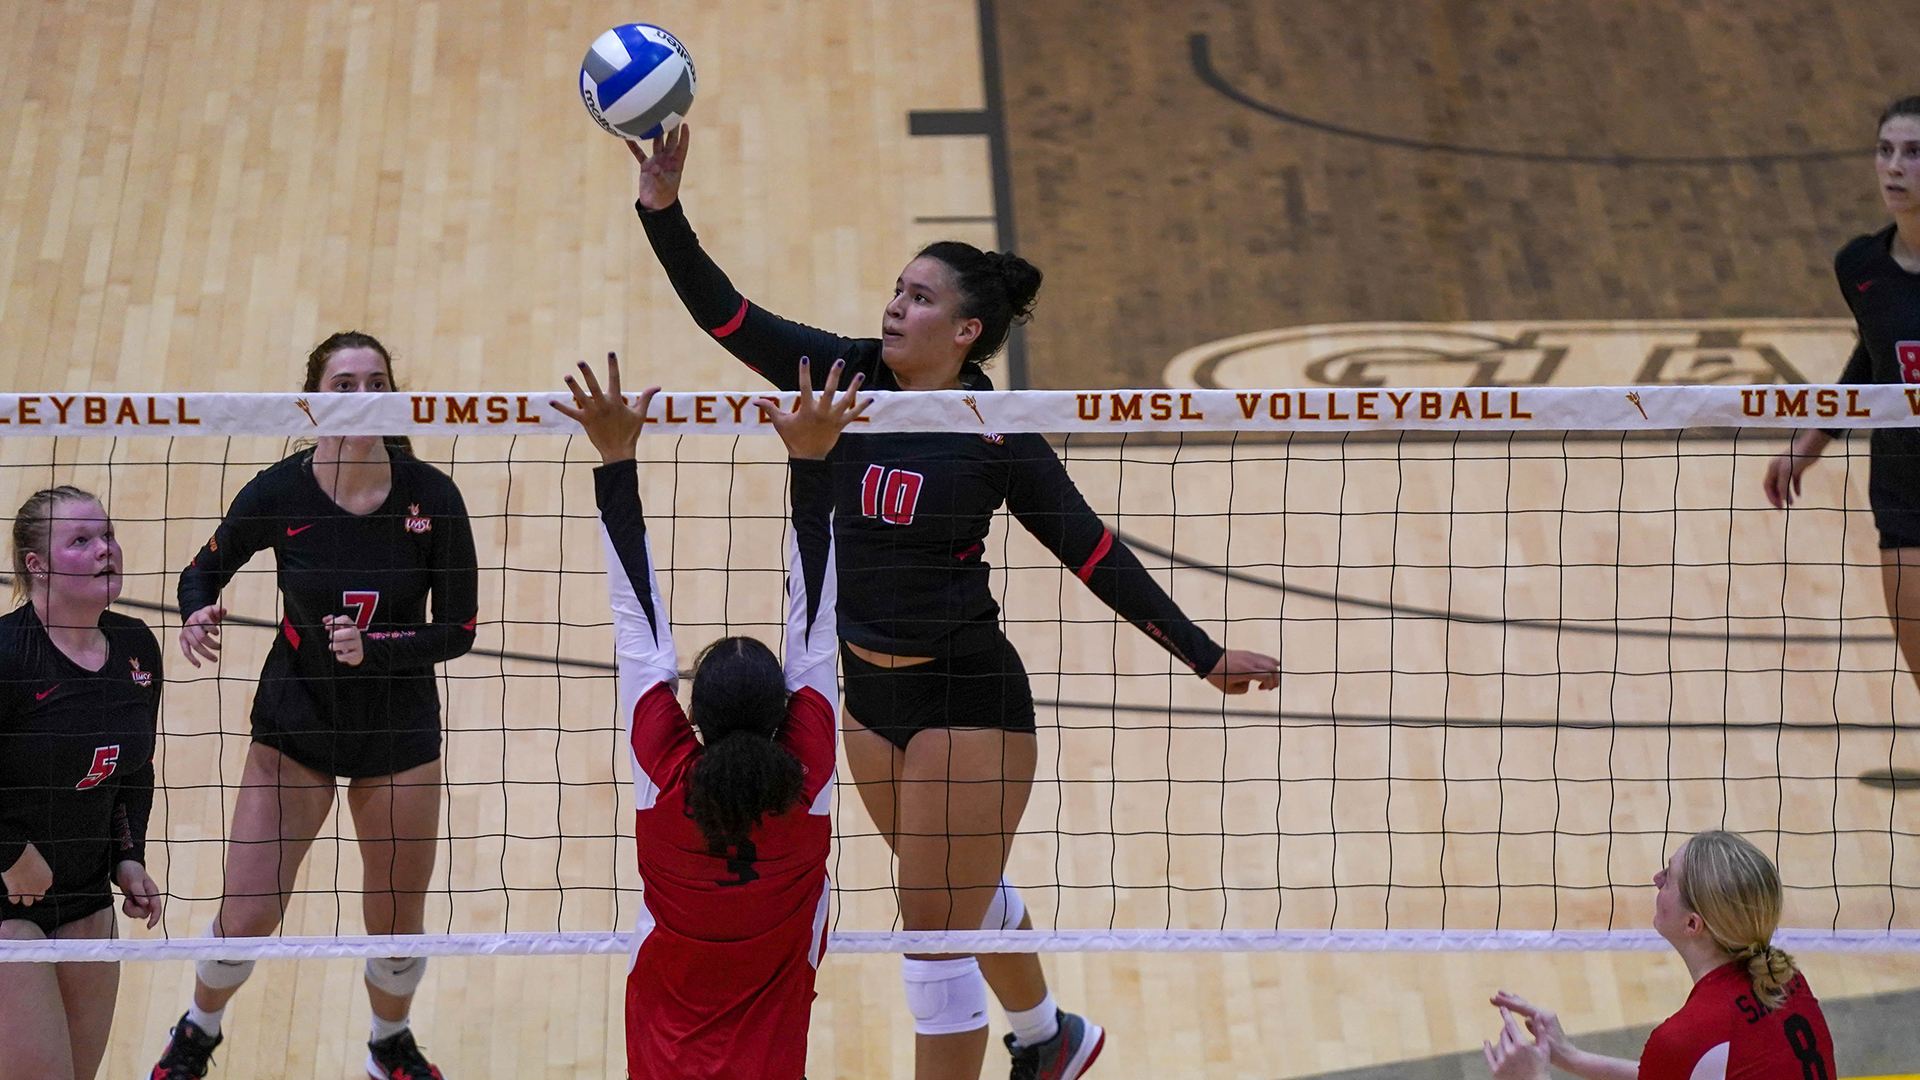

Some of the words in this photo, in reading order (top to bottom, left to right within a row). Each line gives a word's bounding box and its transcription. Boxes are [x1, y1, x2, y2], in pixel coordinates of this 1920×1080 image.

[410, 396, 541, 424] UMSL
[1076, 393, 1204, 421] UMSL
[1235, 391, 1533, 421] VOLLEYBALL
[1740, 389, 1871, 418] UMSL
[861, 463, 924, 526] 10
[343, 591, 380, 632] 7
[75, 744, 120, 791] 5
